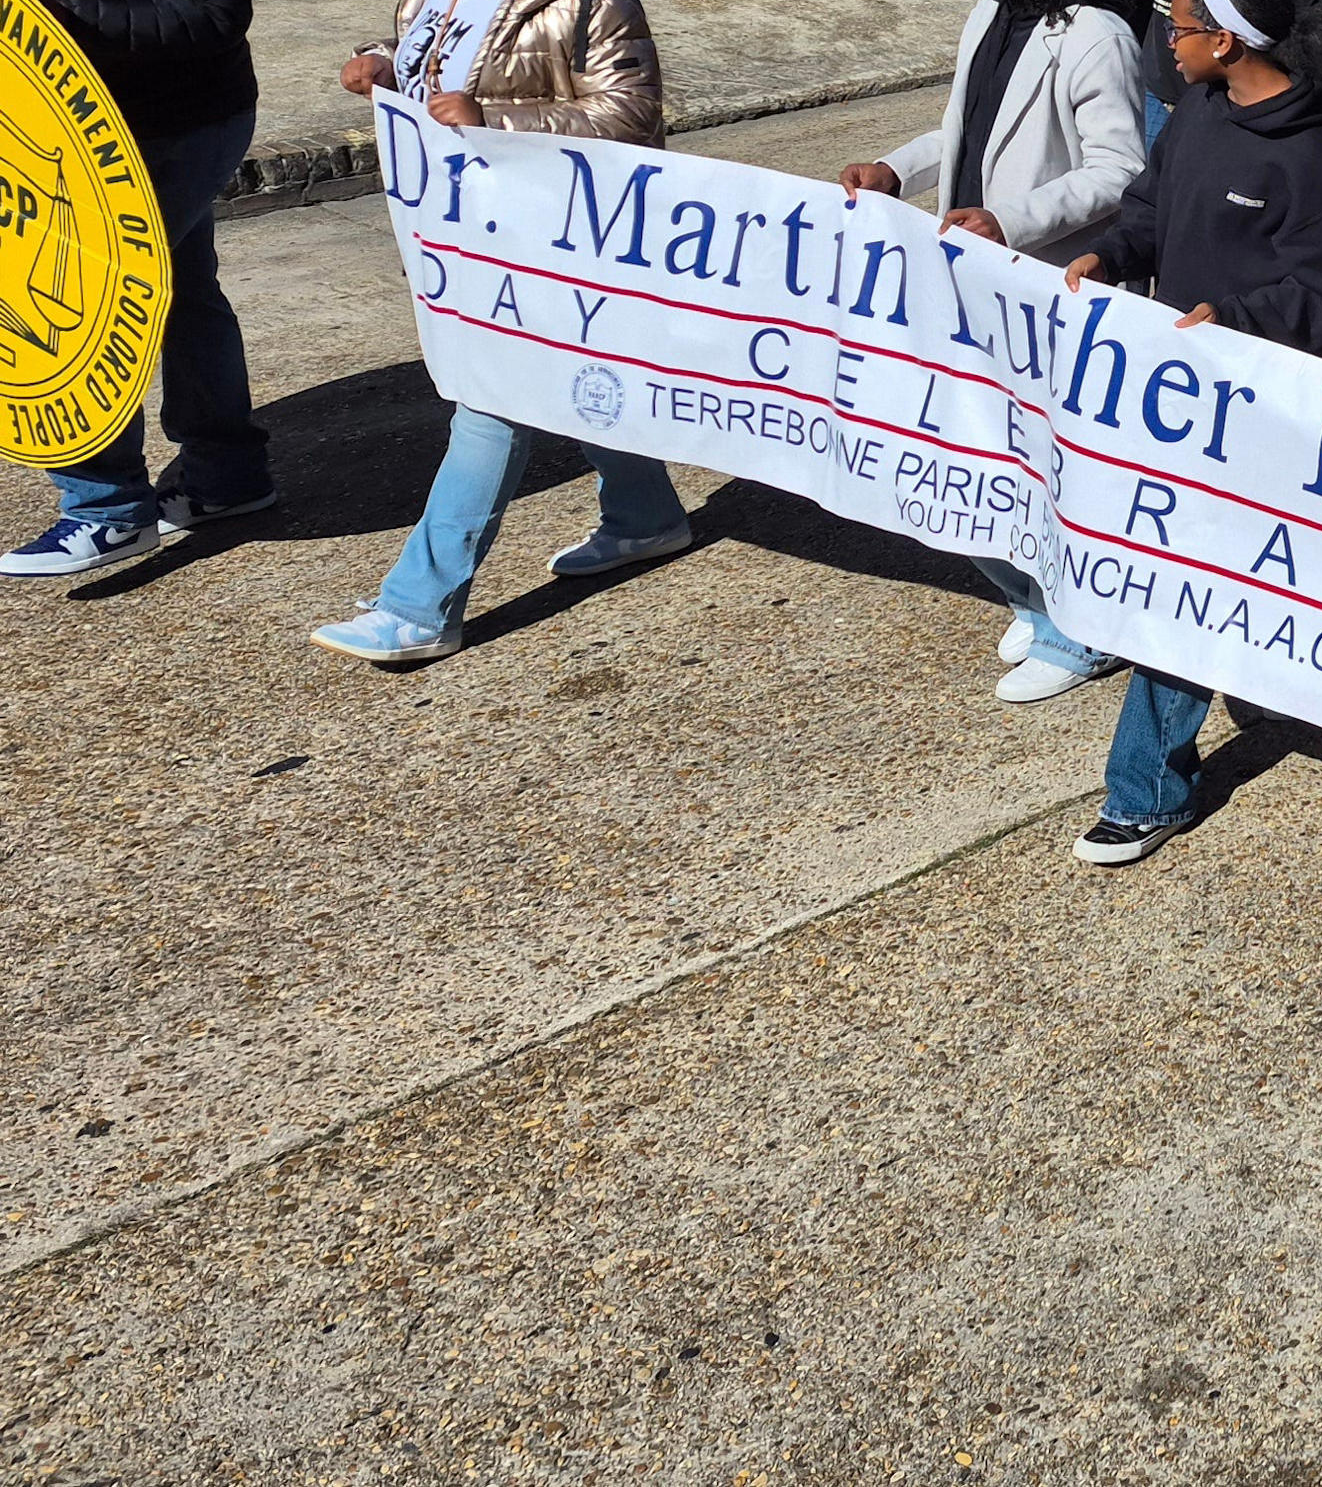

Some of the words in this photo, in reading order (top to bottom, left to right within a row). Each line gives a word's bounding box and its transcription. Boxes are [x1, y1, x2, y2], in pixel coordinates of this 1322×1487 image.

[118, 213, 154, 258] OF
[378, 101, 498, 233] Dr.
[552, 147, 909, 327] Martin
[939, 239, 1256, 463] Luther
[85, 274, 154, 413] COLORED
[421, 249, 607, 345] DAY
[7, 391, 91, 447] PEOPLE
[645, 381, 885, 481] TERREBONNE
[895, 450, 1032, 526] PARISH
[895, 492, 995, 543] YOUTH
